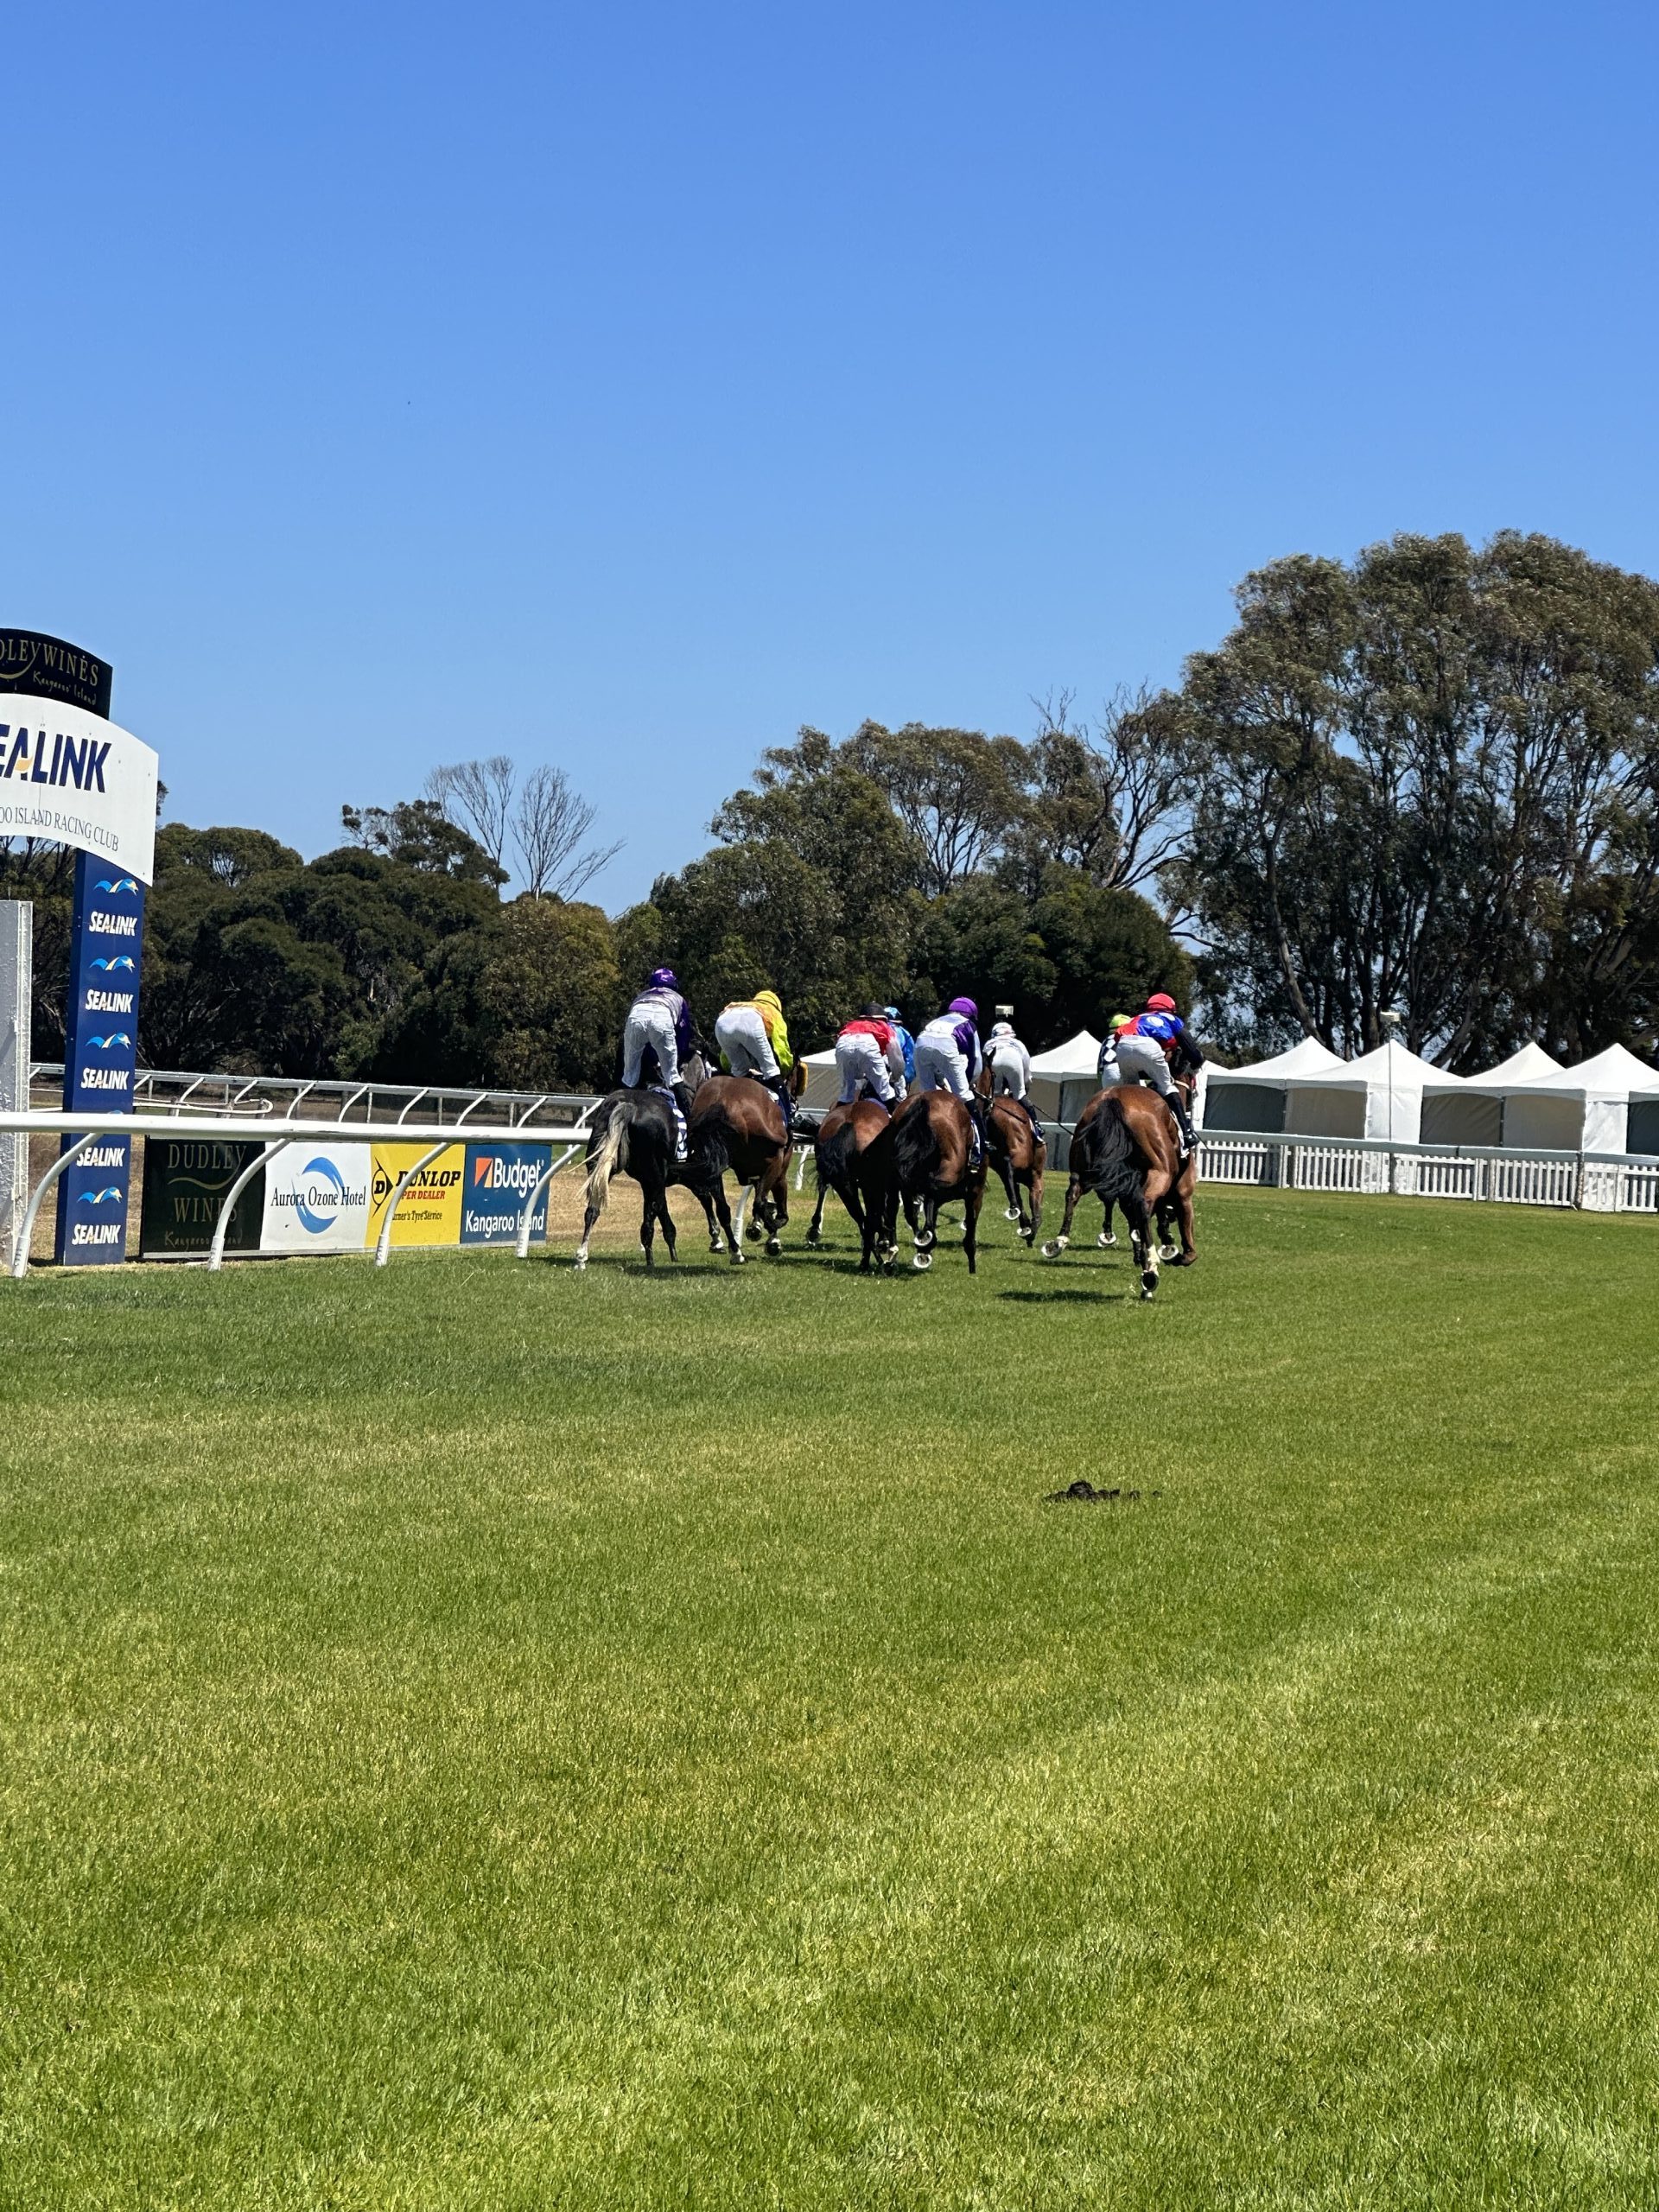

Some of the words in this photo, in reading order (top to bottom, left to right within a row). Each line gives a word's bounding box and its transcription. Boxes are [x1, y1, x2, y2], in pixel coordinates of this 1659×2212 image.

[43, 643, 99, 687] WINES
[33, 670, 70, 692] Kangaroo
[73, 684, 97, 706] Island
[15, 807, 52, 827] ISLAND
[54, 812, 92, 839] RACING
[93, 826, 119, 852] CLUB
[88, 911, 138, 937] SEALINK
[85, 988, 134, 1014] SEALINK
[80, 1067, 130, 1090] SEALINK
[76, 1147, 126, 1167] SEALINK
[168, 1143, 247, 1173] DUDLEY
[396, 1170, 461, 1187] DUNLOP
[493, 1157, 542, 1198] Budget
[270, 1186, 305, 1207] Aurora
[308, 1185, 338, 1206] Ozone
[340, 1185, 366, 1206] Hotel
[400, 1190, 416, 1200] PER
[417, 1190, 446, 1200] DEALER
[411, 1210, 423, 1224] Tyre
[423, 1210, 443, 1221] Service
[465, 1210, 515, 1239] Kangaroo
[516, 1208, 545, 1231] Isand
[72, 1224, 122, 1246] SEALINK
